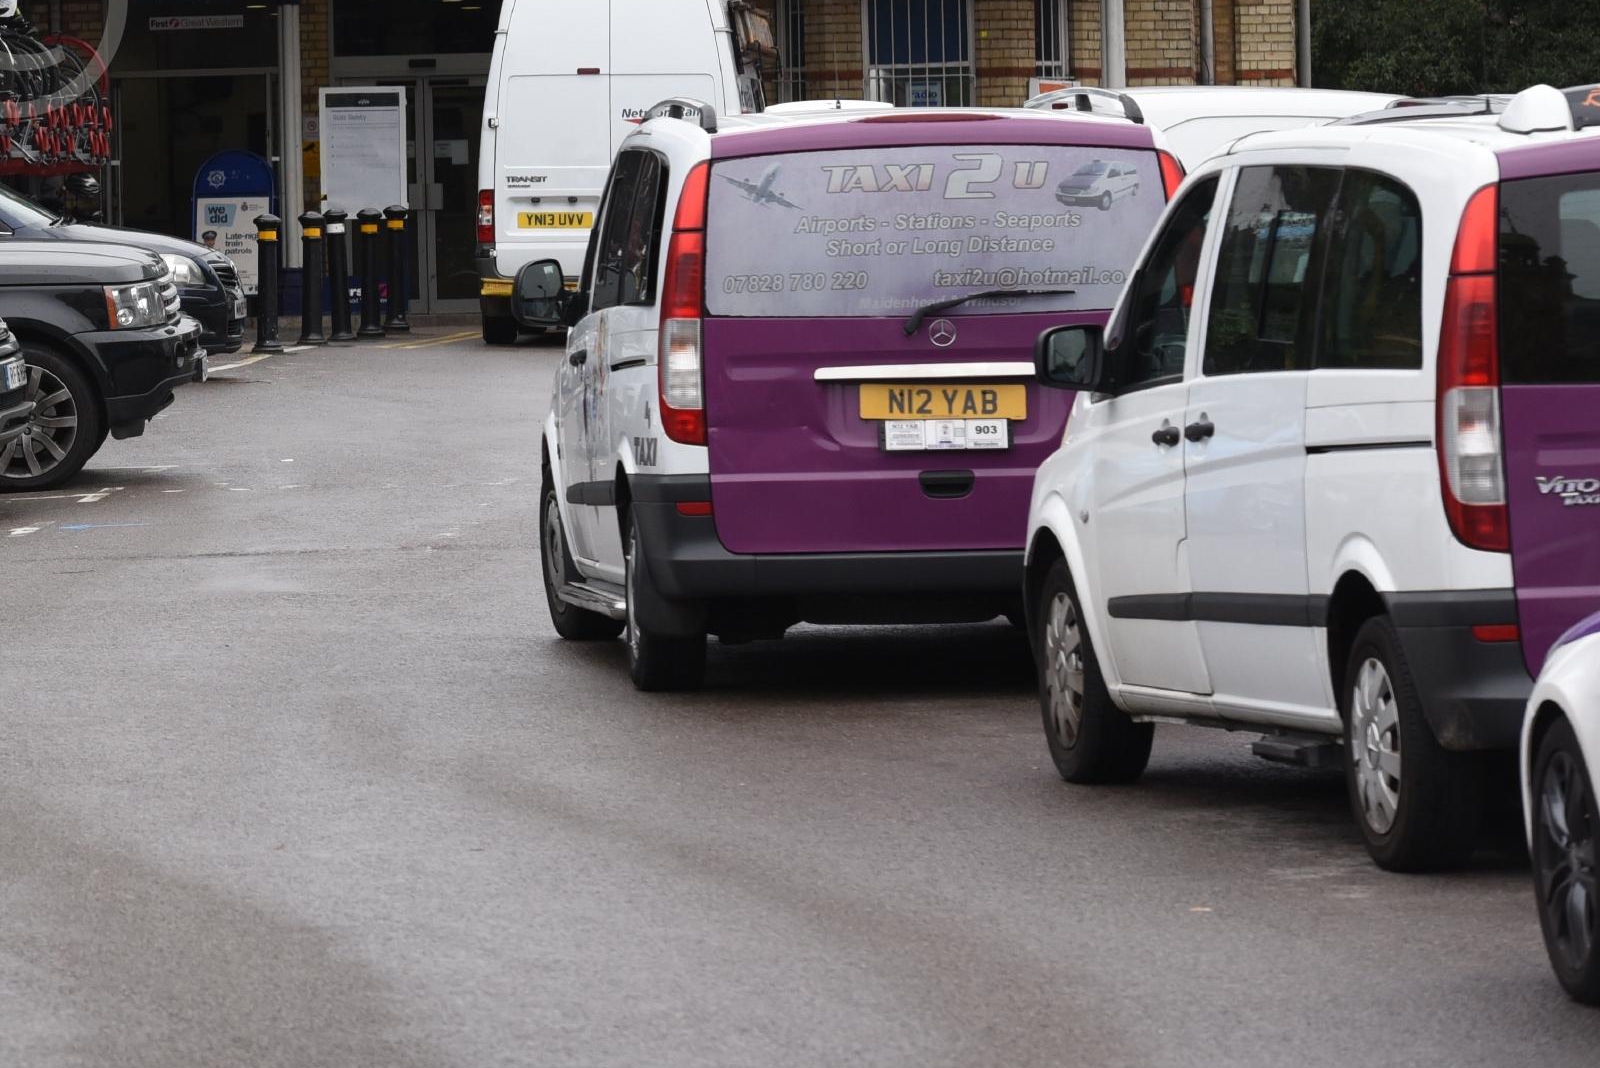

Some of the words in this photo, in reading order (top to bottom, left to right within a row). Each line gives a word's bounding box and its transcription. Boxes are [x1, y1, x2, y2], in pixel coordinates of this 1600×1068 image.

[151, 19, 168, 28] First
[207, 17, 242, 28] Western
[821, 163, 936, 194] TAXI
[943, 152, 1004, 200] 2
[207, 206, 226, 215] we
[209, 214, 228, 224] did
[526, 214, 555, 226] YN13
[559, 214, 584, 226] UVV
[794, 216, 876, 235] Airports
[894, 212, 976, 231] Stations
[993, 210, 1082, 230] Seaports
[225, 232, 258, 242] Late-nig
[225, 247, 252, 255] patrols
[825, 236, 881, 257] Short
[886, 239, 907, 255] or
[911, 236, 962, 257] Long
[967, 235, 1055, 253] Distance
[723, 274, 785, 294] 07828
[789, 273, 826, 292] 780
[831, 271, 869, 291] 220
[933, 266, 1125, 290] taxi2u@hotmail.co
[888, 388, 933, 414] N12
[941, 388, 998, 415] YAB
[974, 425, 998, 435] 903
[633, 436, 658, 467] TAXI
